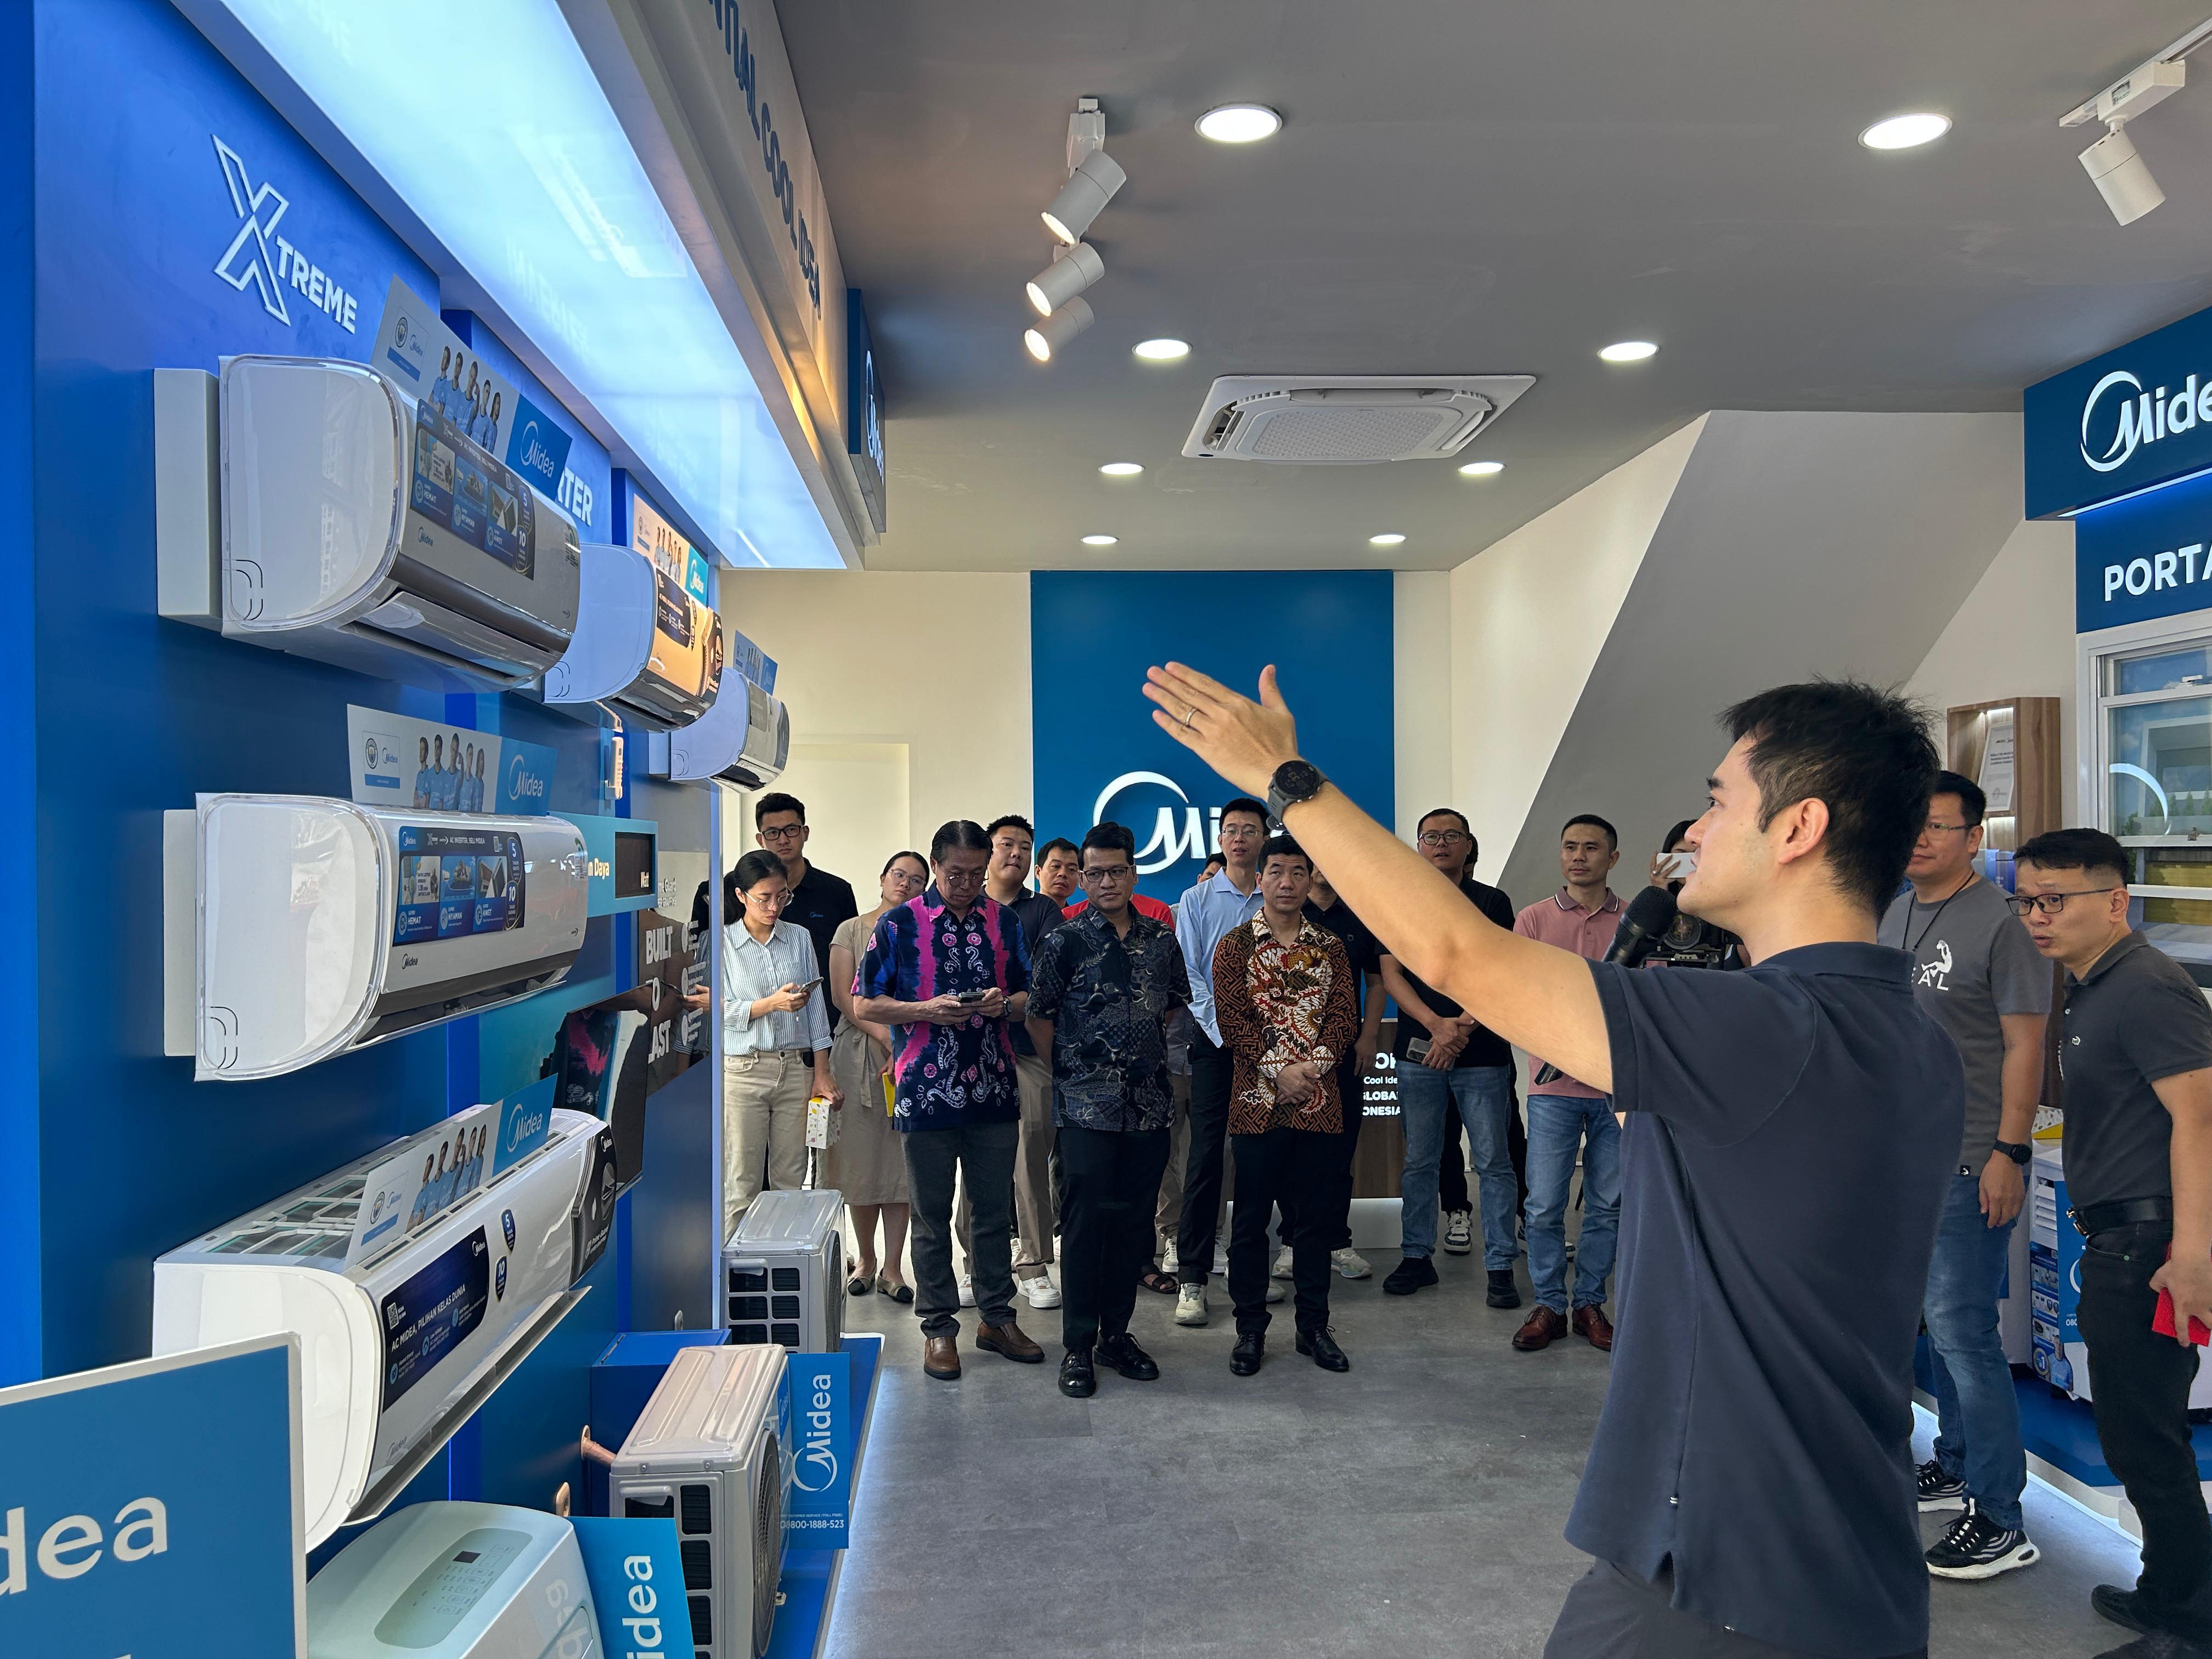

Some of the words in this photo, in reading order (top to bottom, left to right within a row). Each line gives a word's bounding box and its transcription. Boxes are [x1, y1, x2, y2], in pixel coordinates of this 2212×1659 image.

[761, 102, 797, 251] COOL
[798, 208, 821, 320] IDEA
[211, 134, 357, 335] XTREME
[520, 420, 554, 478] Midea
[523, 492, 528, 507] 5
[417, 527, 433, 547] Midea
[519, 531, 526, 547] 10
[509, 754, 543, 801] Midea
[511, 843, 516, 857] 5
[594, 858, 610, 880] Daya
[509, 886, 516, 902] 10
[408, 916, 421, 925] HEMAT
[448, 912, 462, 921] NYAMAN
[646, 926, 674, 965] BUILT
[401, 953, 418, 970] Midea
[1911, 967, 1949, 991] AL
[646, 977, 661, 1012] O
[1363, 1076, 1383, 1085] Cool
[1385, 1076, 1398, 1084] Ide
[1363, 1091, 1398, 1101] LOBA
[1362, 1106, 1401, 1116] ONESIA
[506, 1103, 543, 1153] Midea
[505, 1214, 510, 1228] 5
[472, 1240, 486, 1256] Midea
[498, 1261, 505, 1277] 10
[391, 1338, 399, 1352] AC
[399, 1324, 417, 1345] MIDEA,
[417, 1306, 437, 1330] PILIHAN
[437, 1295, 452, 1313] KELAS
[452, 1284, 466, 1301] DUNIA
[791, 1374, 838, 1492] Midea
